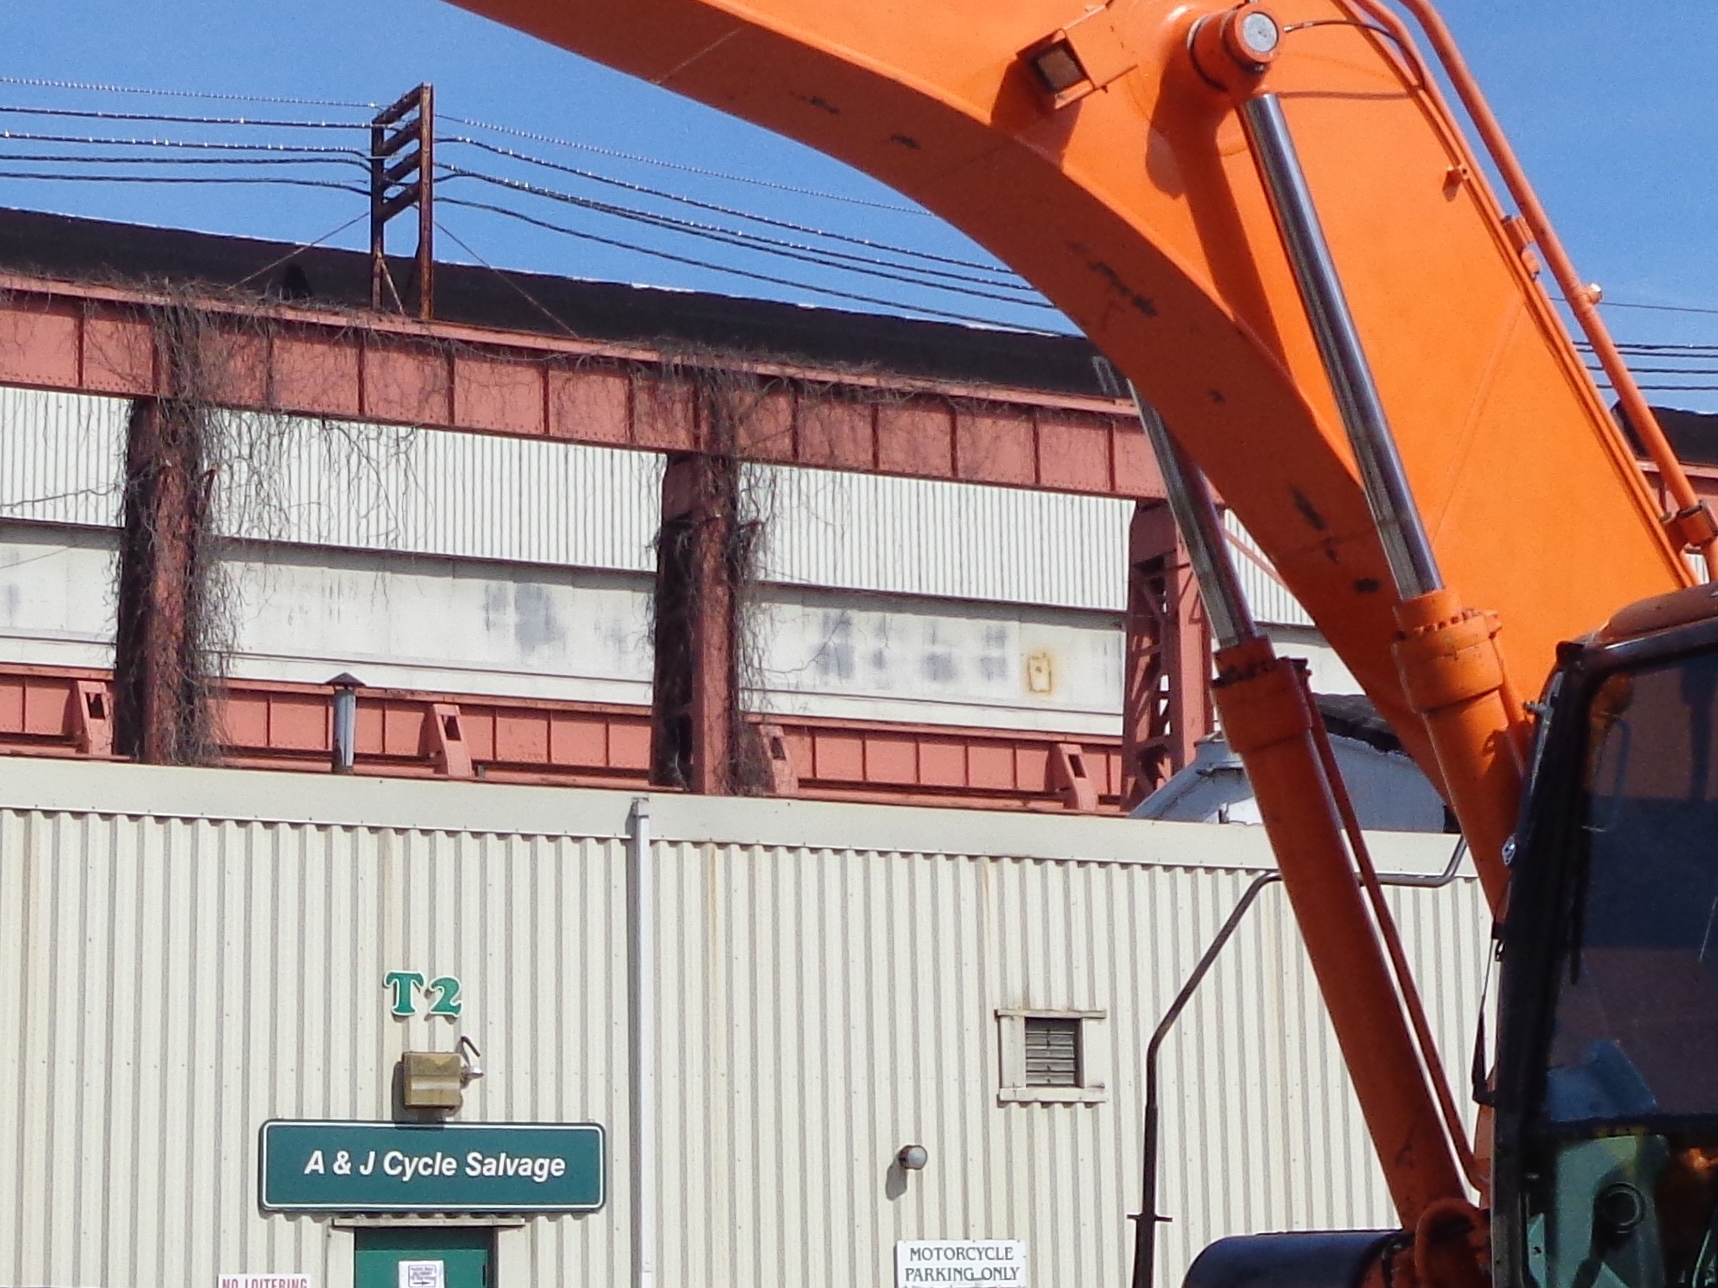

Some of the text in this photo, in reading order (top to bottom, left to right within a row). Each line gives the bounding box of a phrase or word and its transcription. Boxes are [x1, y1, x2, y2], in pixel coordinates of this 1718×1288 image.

[304, 1150, 566, 1182] A & J Cycle Salvage
[909, 1247, 1014, 1261] MOTORCYCLE
[905, 1266, 1020, 1281] PARKING ONLY
